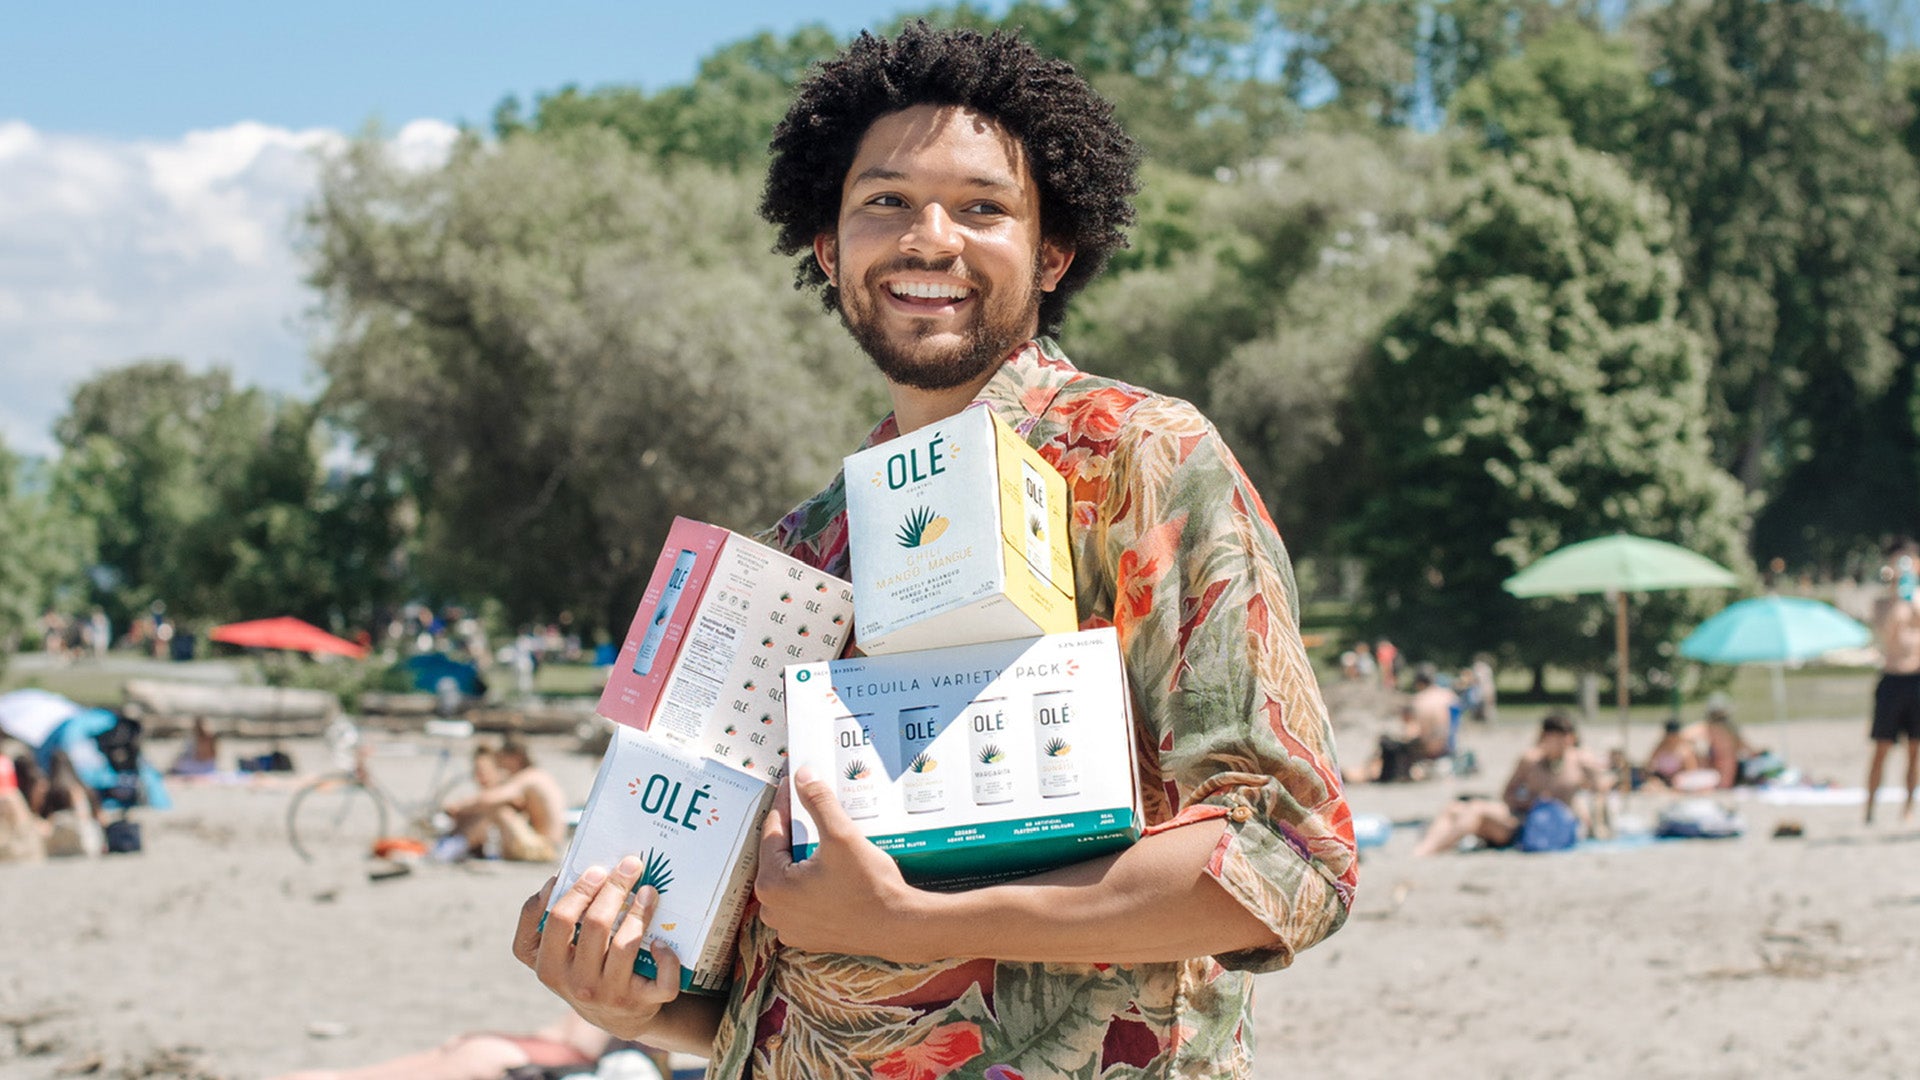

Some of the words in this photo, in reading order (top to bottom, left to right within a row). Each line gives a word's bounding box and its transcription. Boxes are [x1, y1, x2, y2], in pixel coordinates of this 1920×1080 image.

[887, 431, 946, 490] OLÉ
[1026, 477, 1044, 509] OLÉ
[788, 567, 804, 581] OLÉ
[875, 566, 921, 590] MANGO
[928, 546, 973, 571] MANGUE
[890, 581, 925, 598] PERFECTLY
[899, 589, 922, 602] MANGO
[911, 590, 942, 604] COCKTAIL
[805, 600, 821, 614] OLÉ
[770, 610, 786, 625] OLÉ
[822, 633, 838, 648] OLÉ
[787, 644, 803, 658] OLÉ
[751, 655, 768, 669] OLÉ
[846, 678, 920, 698] TEQUILA
[931, 669, 1004, 688] VARIETY
[1015, 663, 1061, 679] PACK
[733, 699, 749, 713] OLÉ
[974, 709, 1005, 733] OLÉ
[1039, 703, 1070, 726] OLÉ
[840, 724, 870, 749] OLÉ
[905, 717, 936, 741] OLÉ
[750, 732, 766, 746] OLÉ
[714, 743, 730, 757] OLÉ
[974, 768, 1011, 778] MARGARITA
[641, 773, 711, 831] OLÉ
